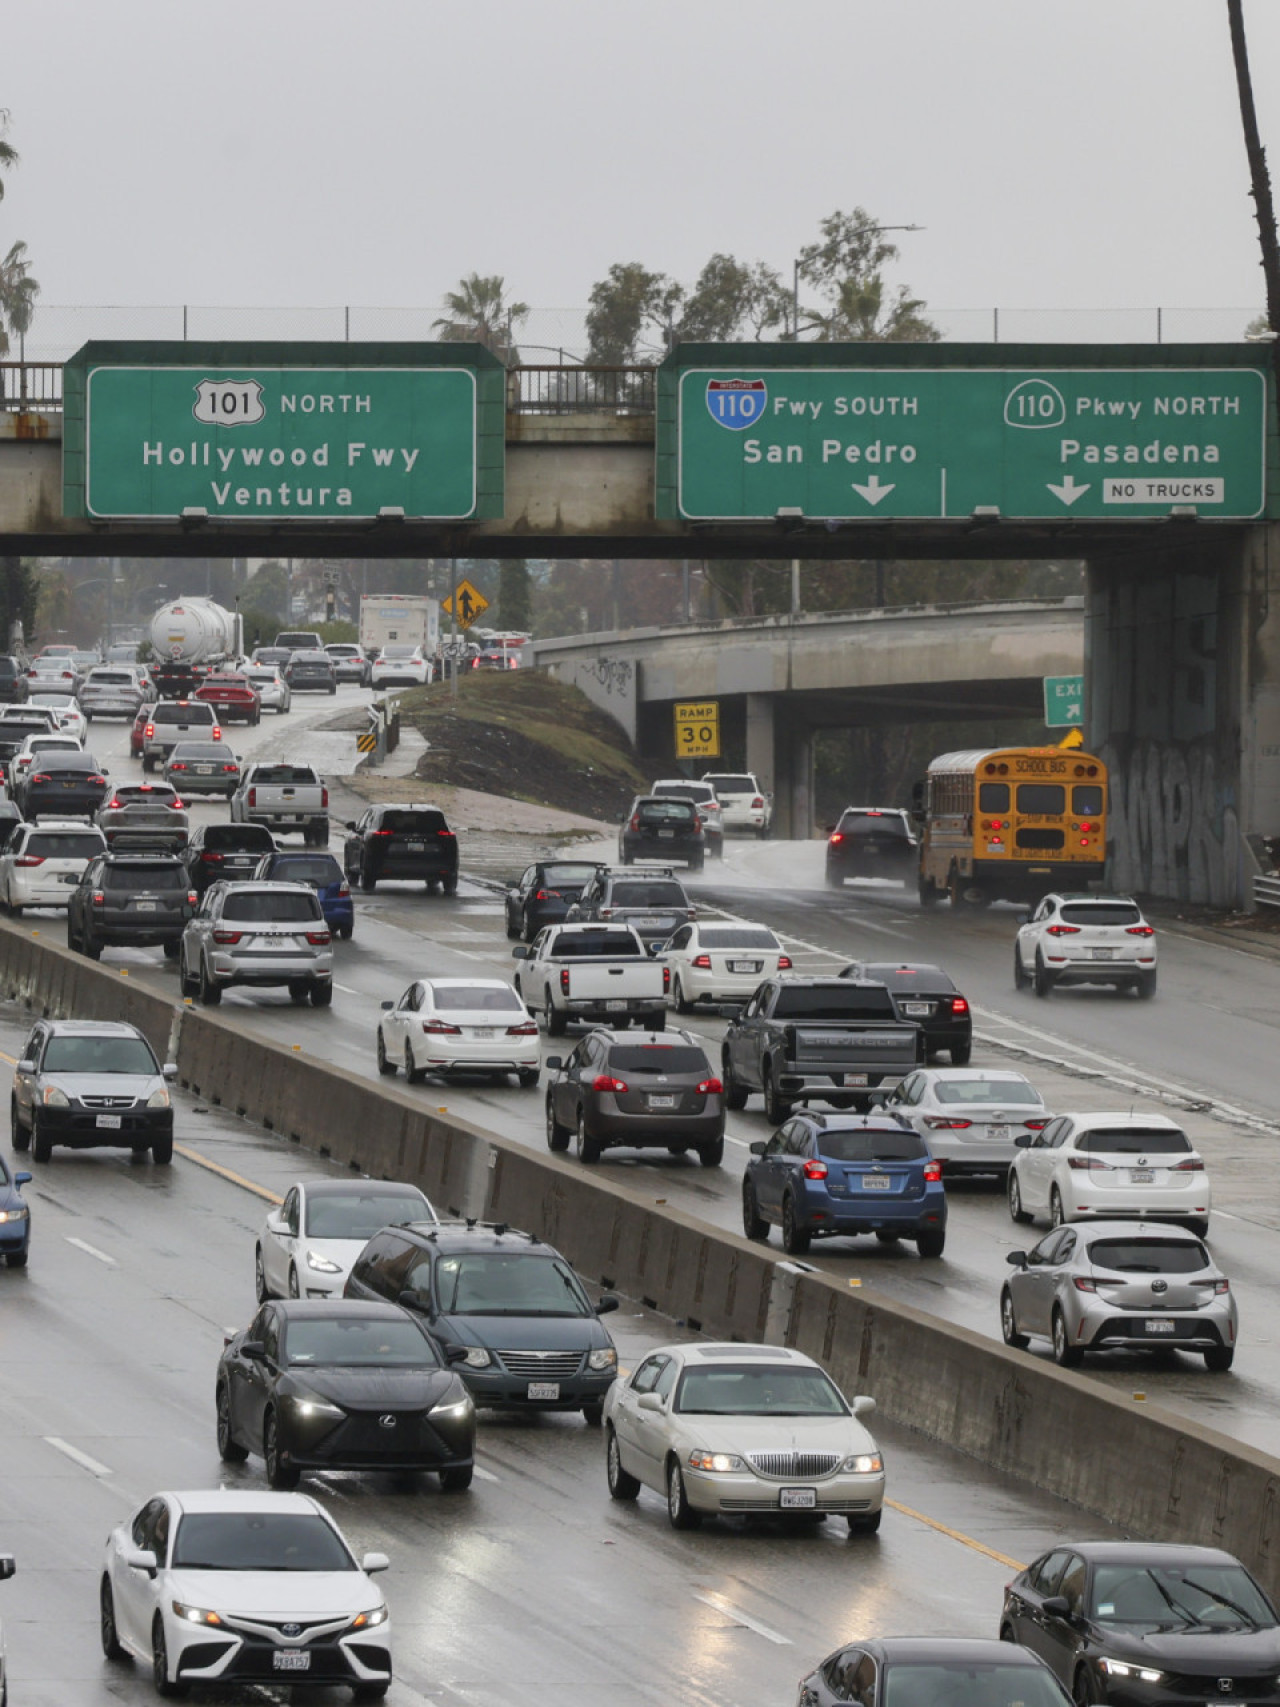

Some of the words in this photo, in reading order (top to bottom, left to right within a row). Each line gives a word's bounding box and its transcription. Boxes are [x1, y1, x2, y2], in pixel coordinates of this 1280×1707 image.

[209, 392, 250, 414] 101
[280, 394, 372, 413] NORTH
[717, 394, 756, 417] 110
[773, 397, 822, 420] Fwy
[833, 397, 918, 416] SOUTH
[1016, 395, 1054, 418] 110
[1075, 397, 1141, 420] Pkwy
[1154, 396, 1240, 416] NORTH
[142, 441, 329, 471] Hollywood
[347, 442, 419, 472] Fwy
[743, 440, 803, 464] San
[822, 440, 917, 464] Pedro
[1060, 440, 1220, 464] Pasadena
[211, 481, 353, 506] Ventura
[1111, 484, 1136, 498] NO
[1146, 483, 1215, 498] TRUCKS
[1056, 684, 1081, 696] EXI
[680, 708, 712, 717] RAMP
[683, 727, 712, 743] 30
[1016, 760, 1048, 773] SCHOOL
[1050, 761, 1066, 773] BUS
